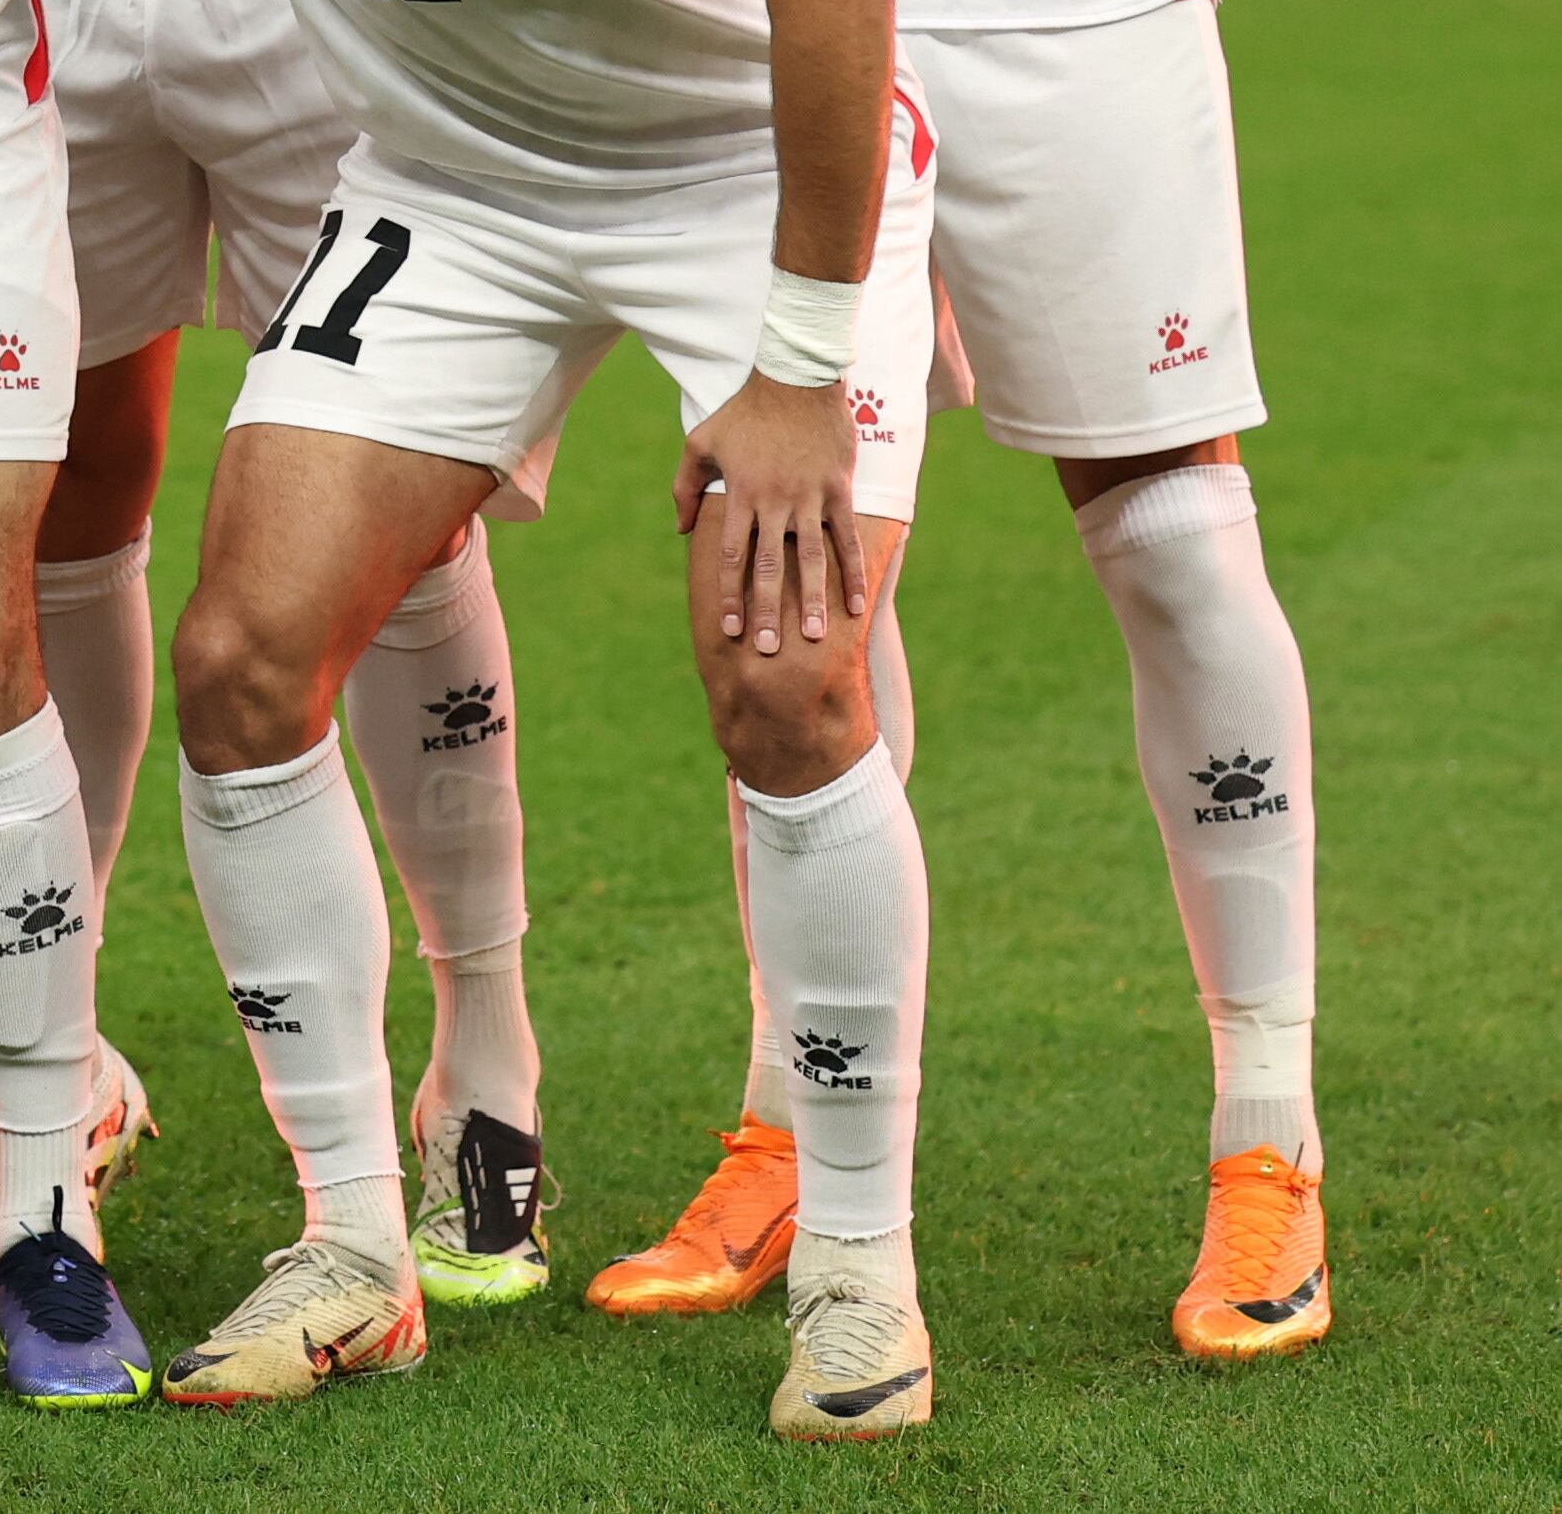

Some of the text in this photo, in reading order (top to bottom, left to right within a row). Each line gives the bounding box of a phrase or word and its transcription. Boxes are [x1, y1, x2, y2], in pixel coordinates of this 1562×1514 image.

[1149, 347, 1209, 374] KELME
[422, 716, 508, 752] KELME
[1193, 793, 1289, 824] KELME
[793, 1057, 873, 1090] KELME
